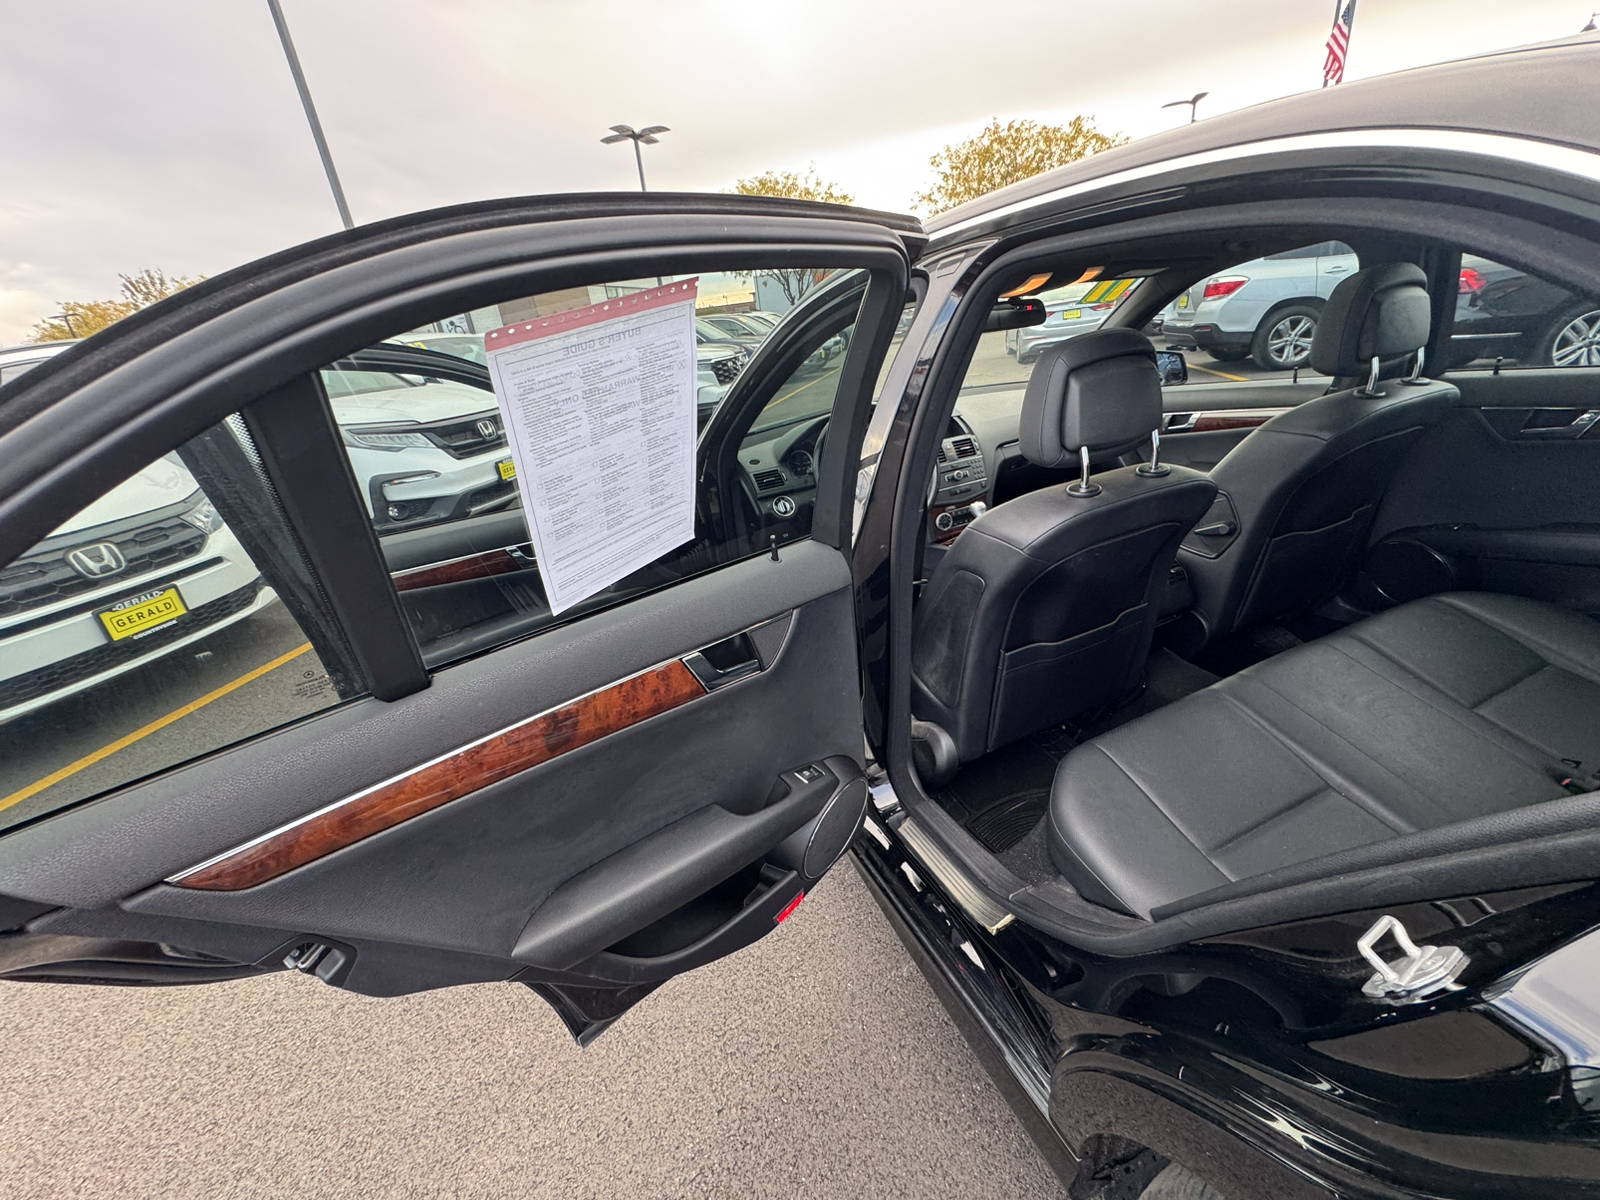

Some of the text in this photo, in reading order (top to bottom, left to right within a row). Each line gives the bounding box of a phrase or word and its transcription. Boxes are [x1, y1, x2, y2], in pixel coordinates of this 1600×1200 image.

[115, 590, 161, 611] GERALD
[116, 601, 173, 628] GERALD
[132, 619, 178, 640] COUNTRYSIDE
